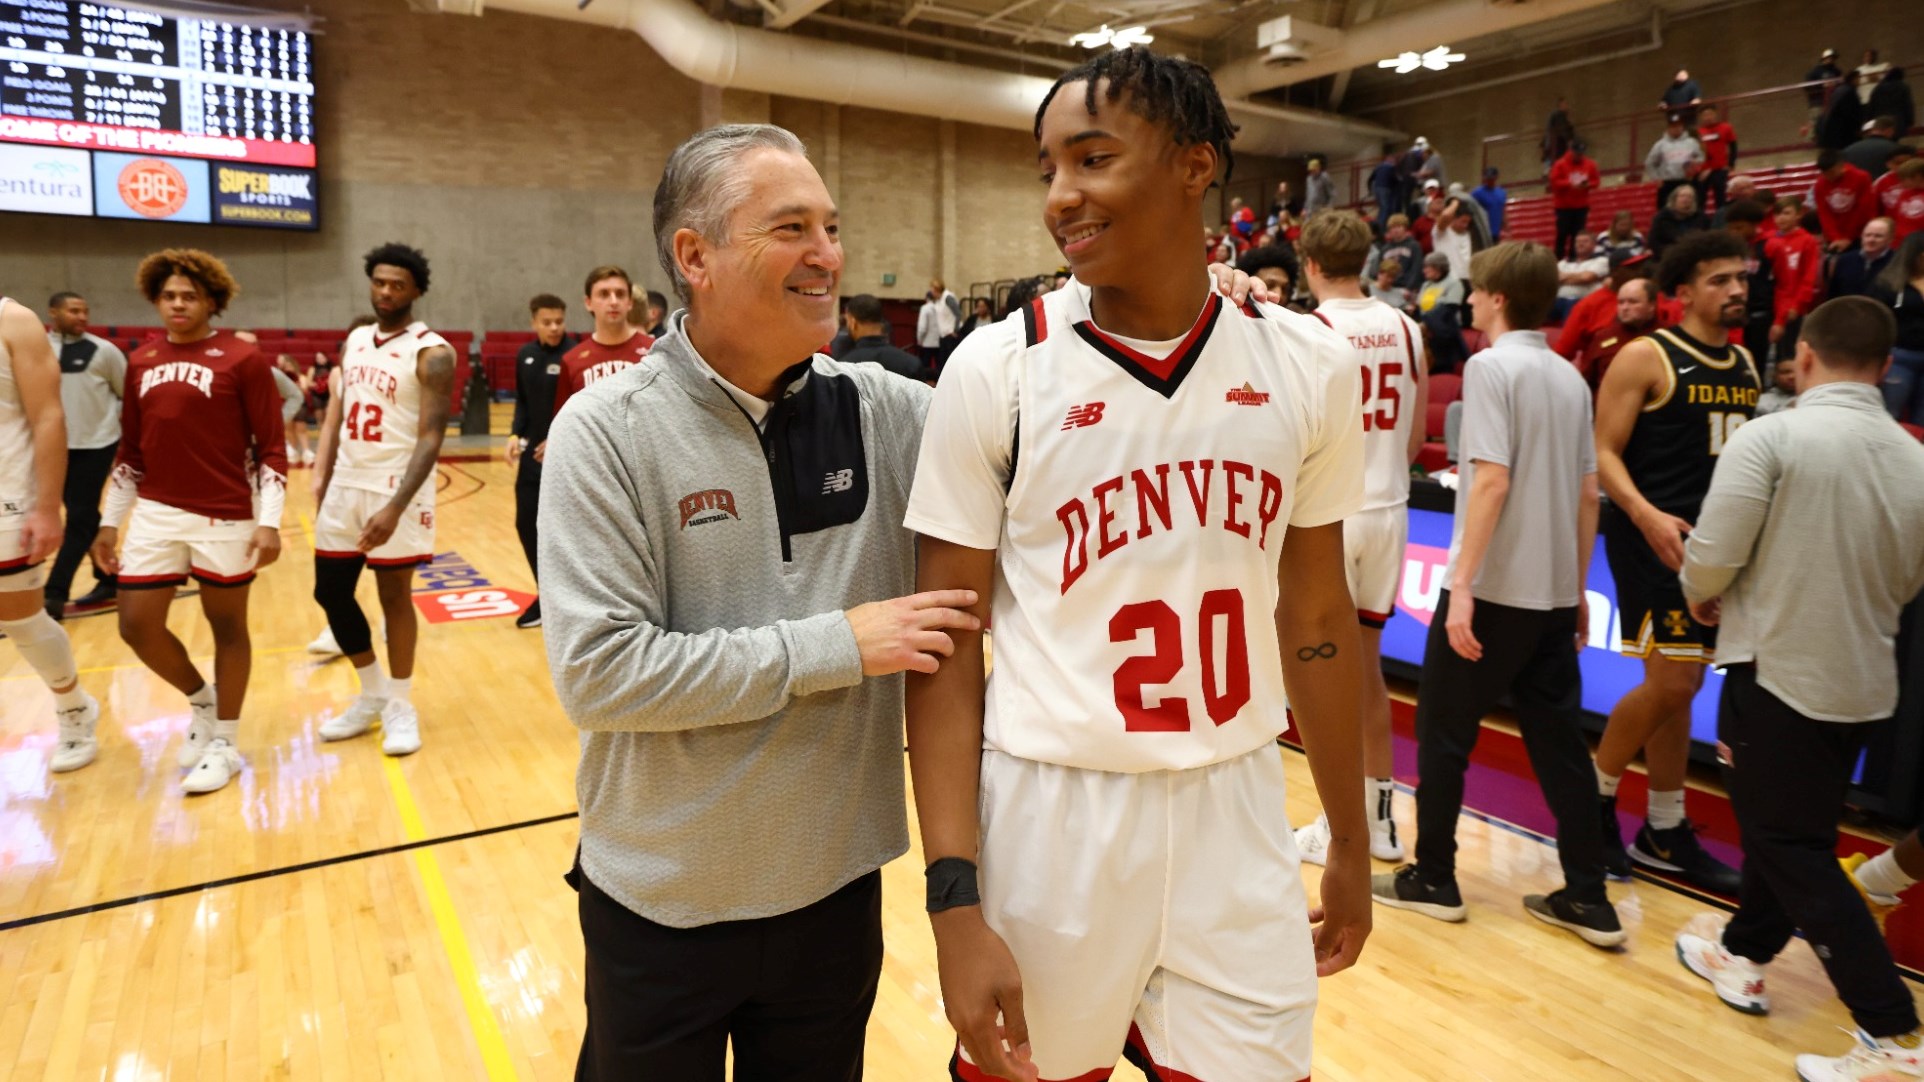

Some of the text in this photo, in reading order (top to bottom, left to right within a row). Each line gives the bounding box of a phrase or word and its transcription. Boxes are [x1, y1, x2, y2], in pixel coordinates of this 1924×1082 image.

[58, 123, 93, 143] OF
[92, 126, 139, 149] THE
[140, 130, 247, 158] PIONEERS
[0, 177, 82, 198] entura
[219, 167, 313, 200] SUPERBOOK
[240, 192, 292, 206] SPORTS
[139, 361, 214, 398] DENVER
[344, 366, 397, 404] DENVER
[583, 360, 634, 388] DENV
[1225, 391, 1269, 403] SUMMIT
[1688, 384, 1757, 407] IDAHO
[346, 401, 383, 442] 42
[678, 489, 739, 530] DENVER
[688, 513, 729, 527] BASKETBALL
[1056, 459, 1283, 597] DENVER
[1108, 588, 1251, 732] 20
